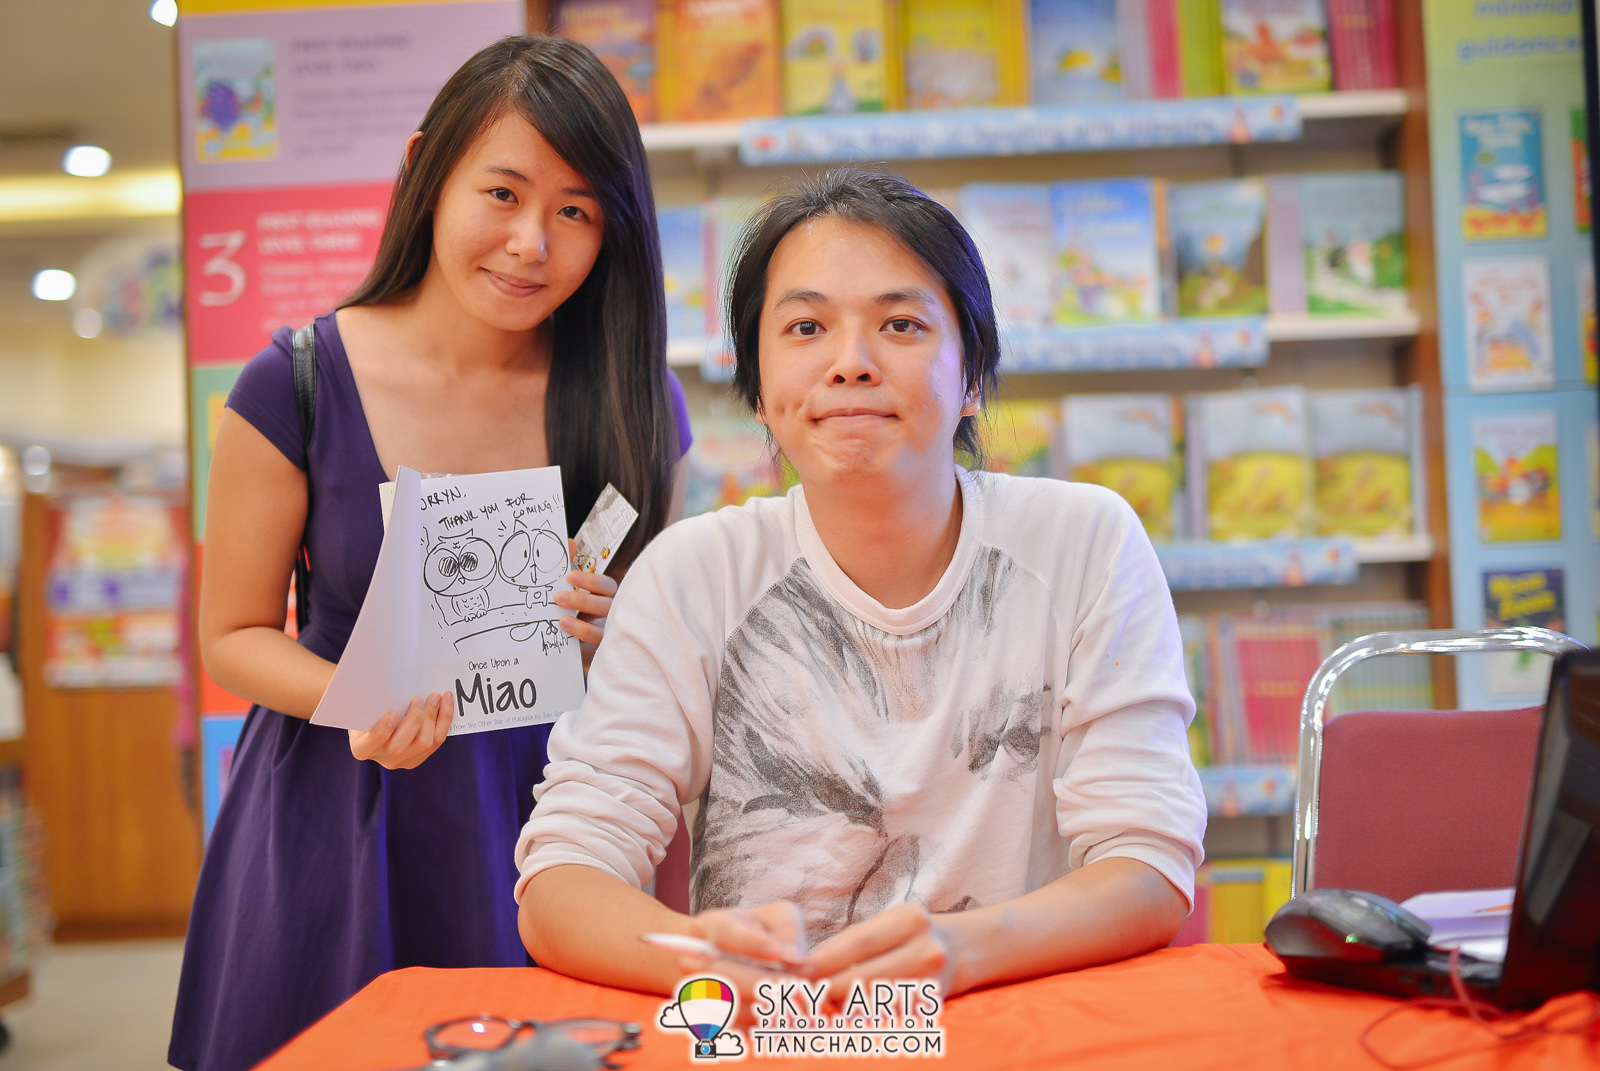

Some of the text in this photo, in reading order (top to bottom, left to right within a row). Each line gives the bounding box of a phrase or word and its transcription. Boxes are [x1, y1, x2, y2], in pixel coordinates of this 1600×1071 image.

[199, 229, 247, 307] 3
[438, 492, 535, 531] THANK YOU FOR
[468, 657, 520, 671] Once Upon a
[455, 672, 537, 717] Miao
